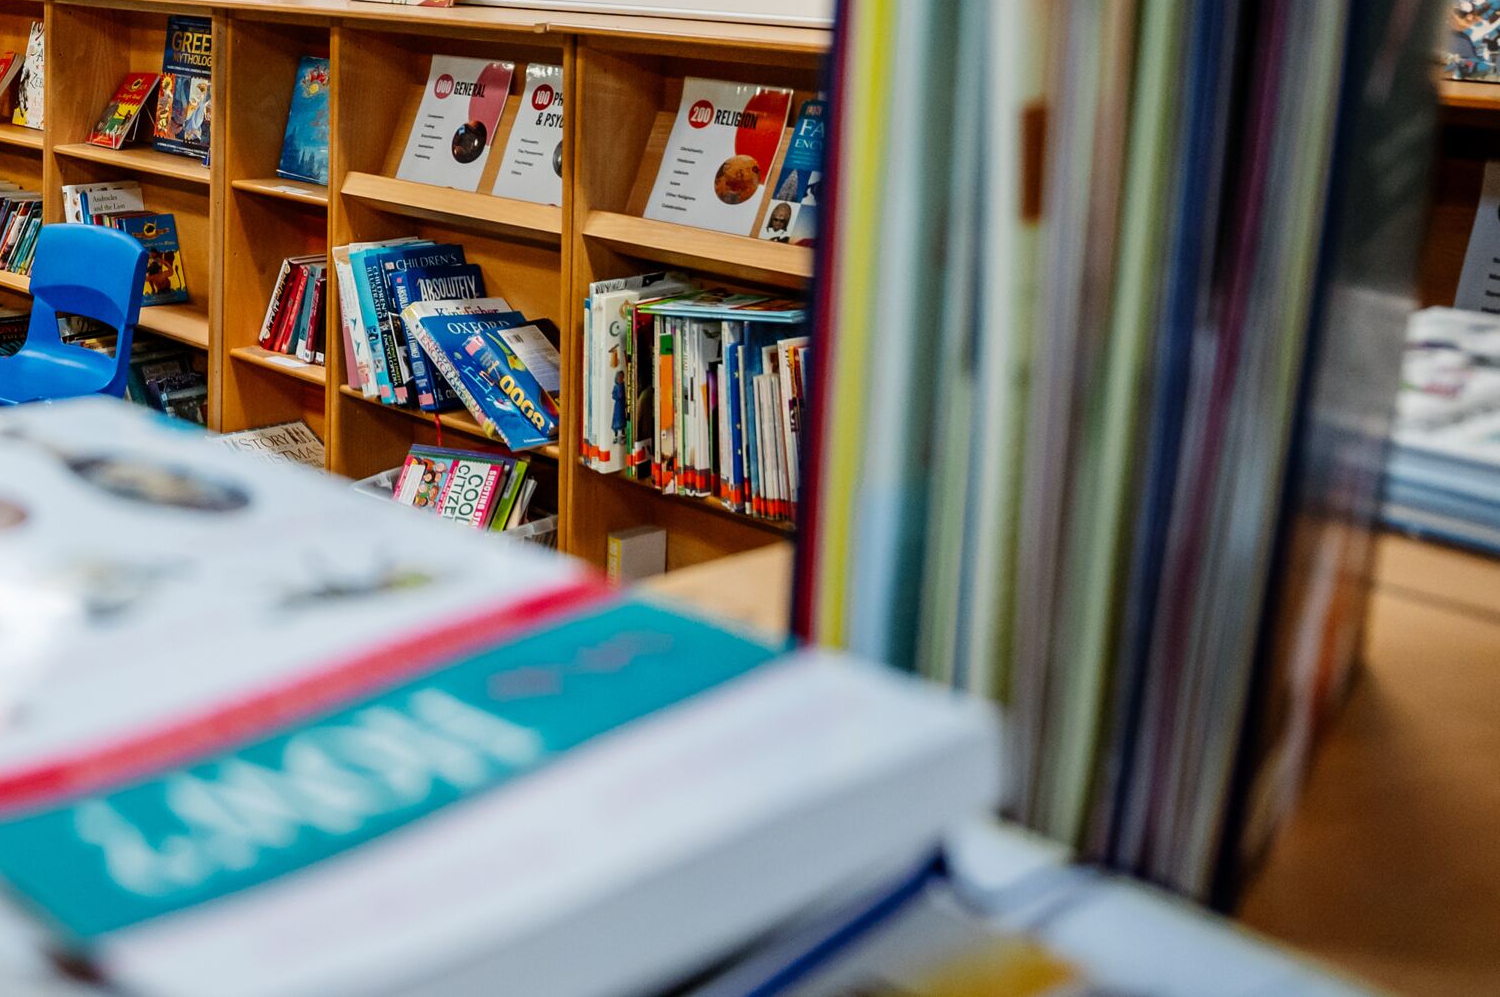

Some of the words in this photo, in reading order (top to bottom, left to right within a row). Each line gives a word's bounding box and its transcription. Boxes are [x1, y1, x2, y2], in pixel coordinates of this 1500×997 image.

[172, 31, 211, 54] GREE
[454, 81, 486, 98] GENERAL
[535, 90, 550, 105] 100
[536, 112, 543, 126] &
[691, 107, 711, 123] 200
[714, 109, 758, 129] RELIGION
[396, 253, 457, 271] CHILDREN'S
[367, 267, 383, 319] ILLUSTRATED
[373, 266, 387, 318] CHILDREN'S
[416, 275, 476, 301] ABSOLUTELY
[383, 334, 398, 387] ENCYCLOPEDIA
[455, 474, 484, 522] COOL
[477, 470, 498, 510] SHOOTING
